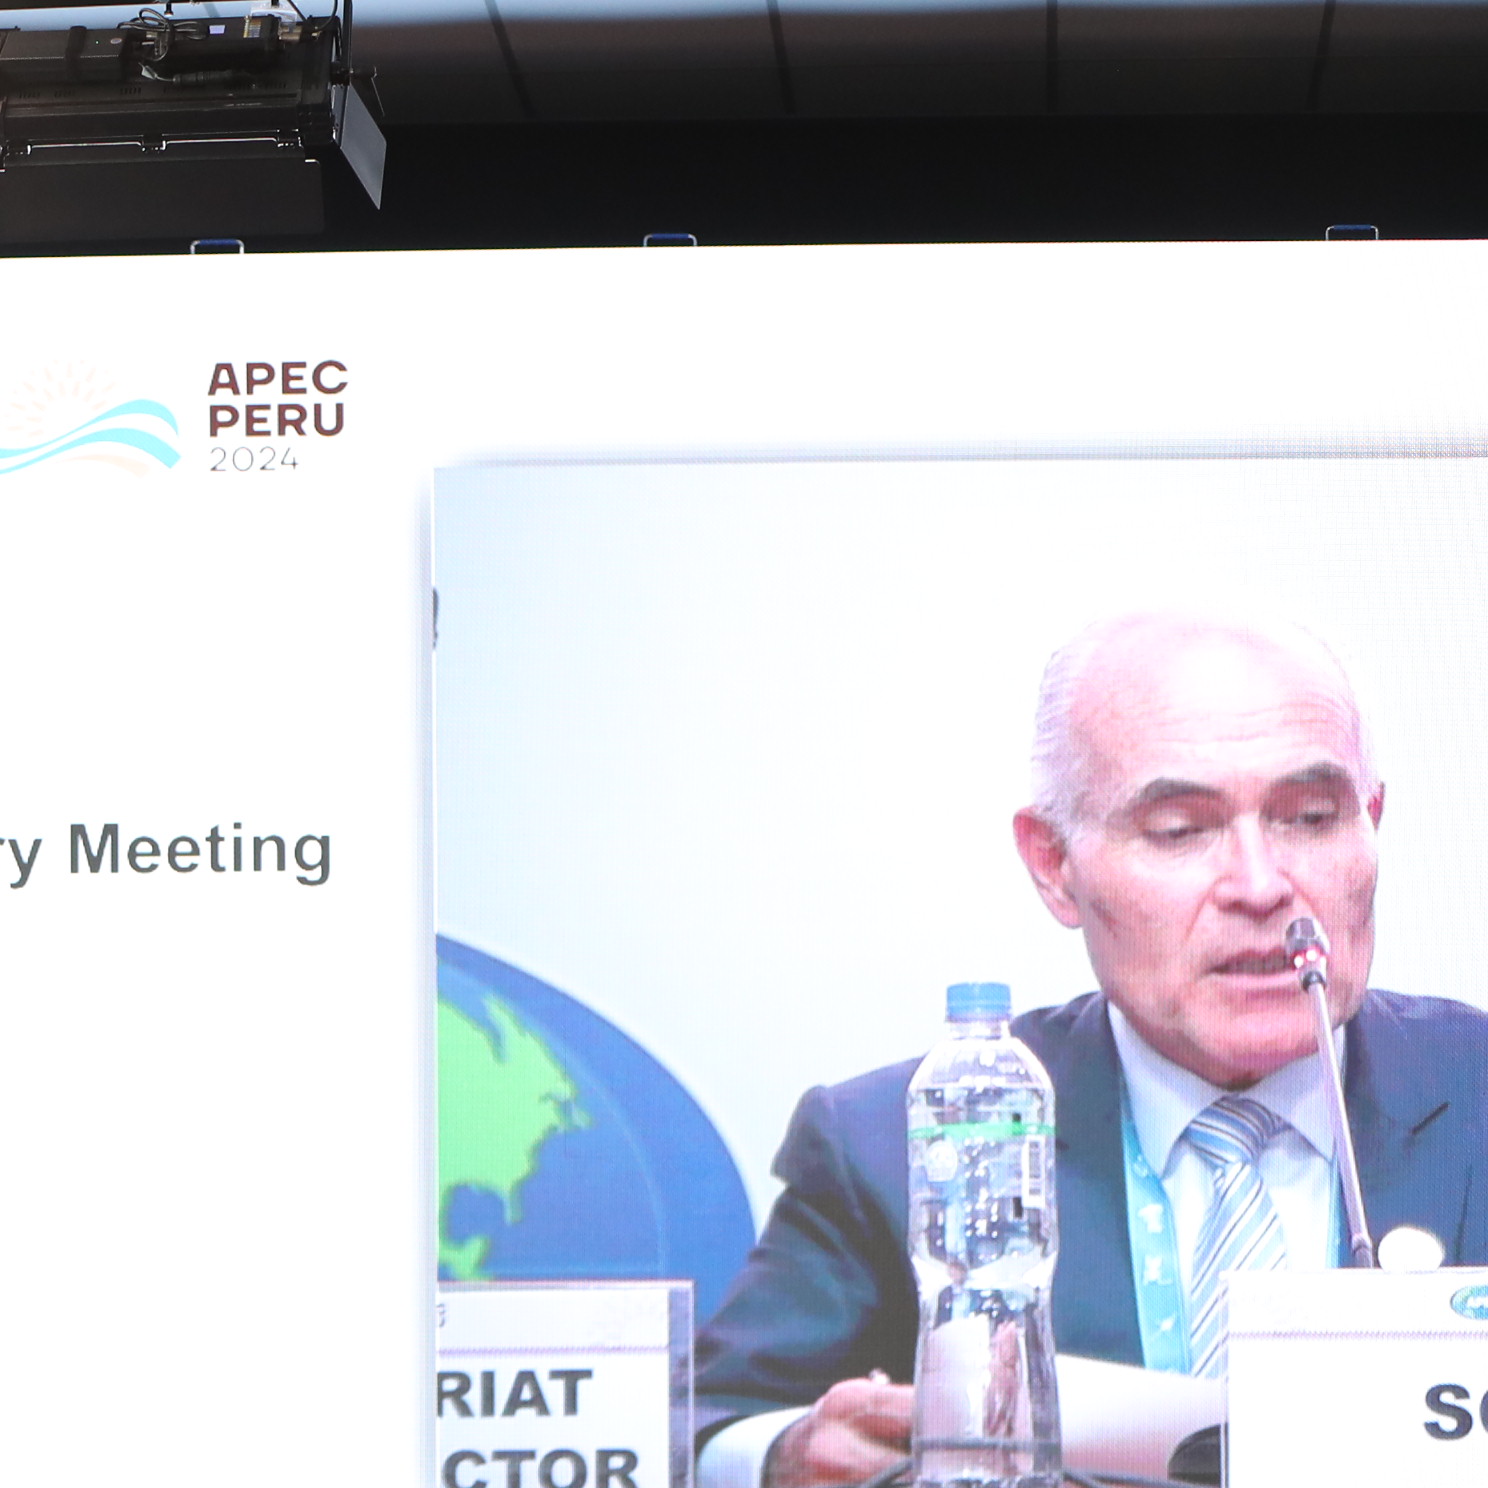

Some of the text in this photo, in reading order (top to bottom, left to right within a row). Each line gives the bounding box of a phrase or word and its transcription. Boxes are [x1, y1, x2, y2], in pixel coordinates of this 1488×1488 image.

[207, 359, 348, 396] APEC
[209, 402, 344, 438] PERU
[210, 446, 298, 472] 2024
[70, 822, 330, 887] Meeting
[436, 1369, 593, 1418] RIAT
